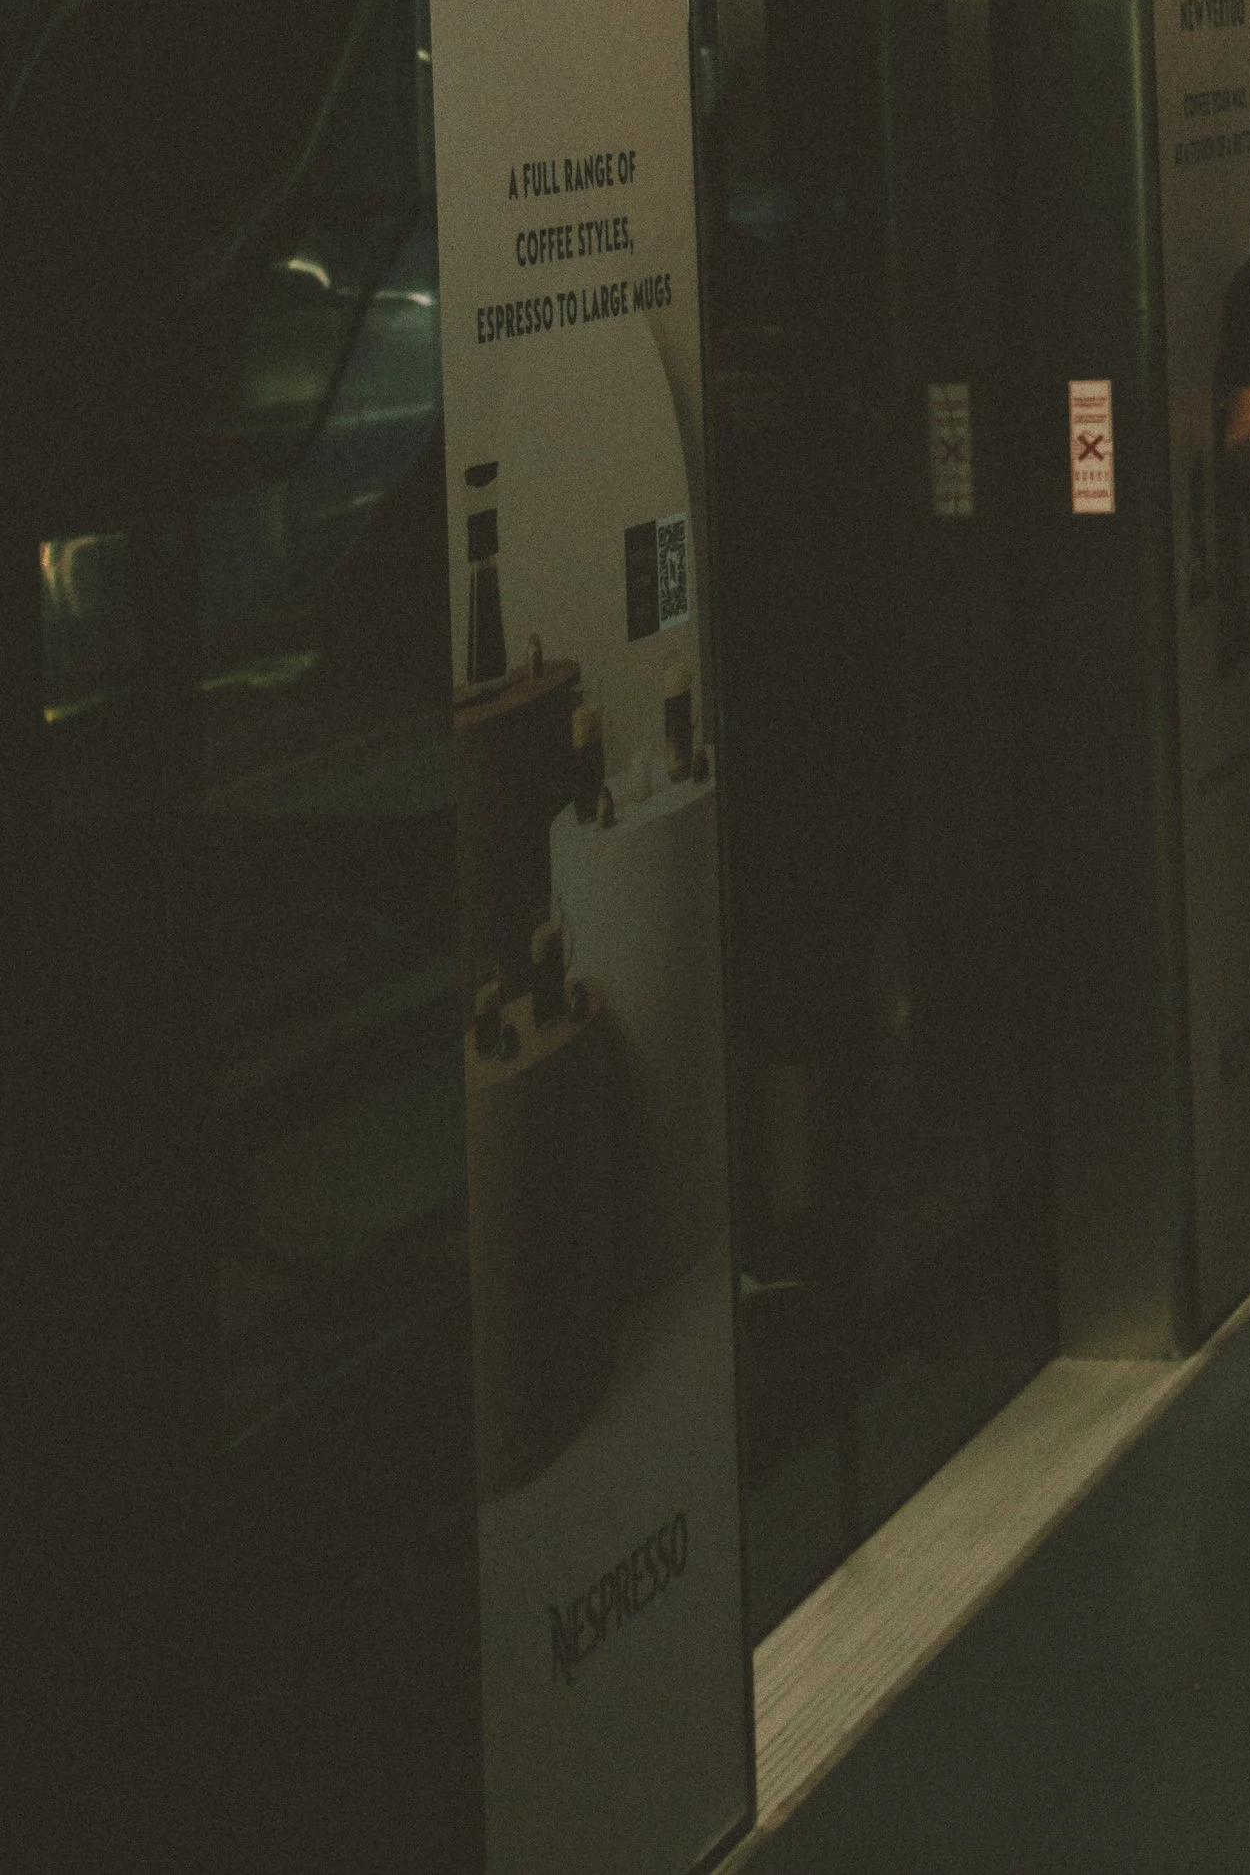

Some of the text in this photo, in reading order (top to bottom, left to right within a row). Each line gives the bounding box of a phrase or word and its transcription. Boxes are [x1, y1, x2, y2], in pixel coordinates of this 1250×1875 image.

[508, 150, 637, 200] A FULL RANGE OF
[516, 216, 635, 267] COFFEE STYLES,
[477, 272, 673, 345] ESPRESSO TO LARGE MUGS
[546, 1511, 689, 1687] NESPRESSO
